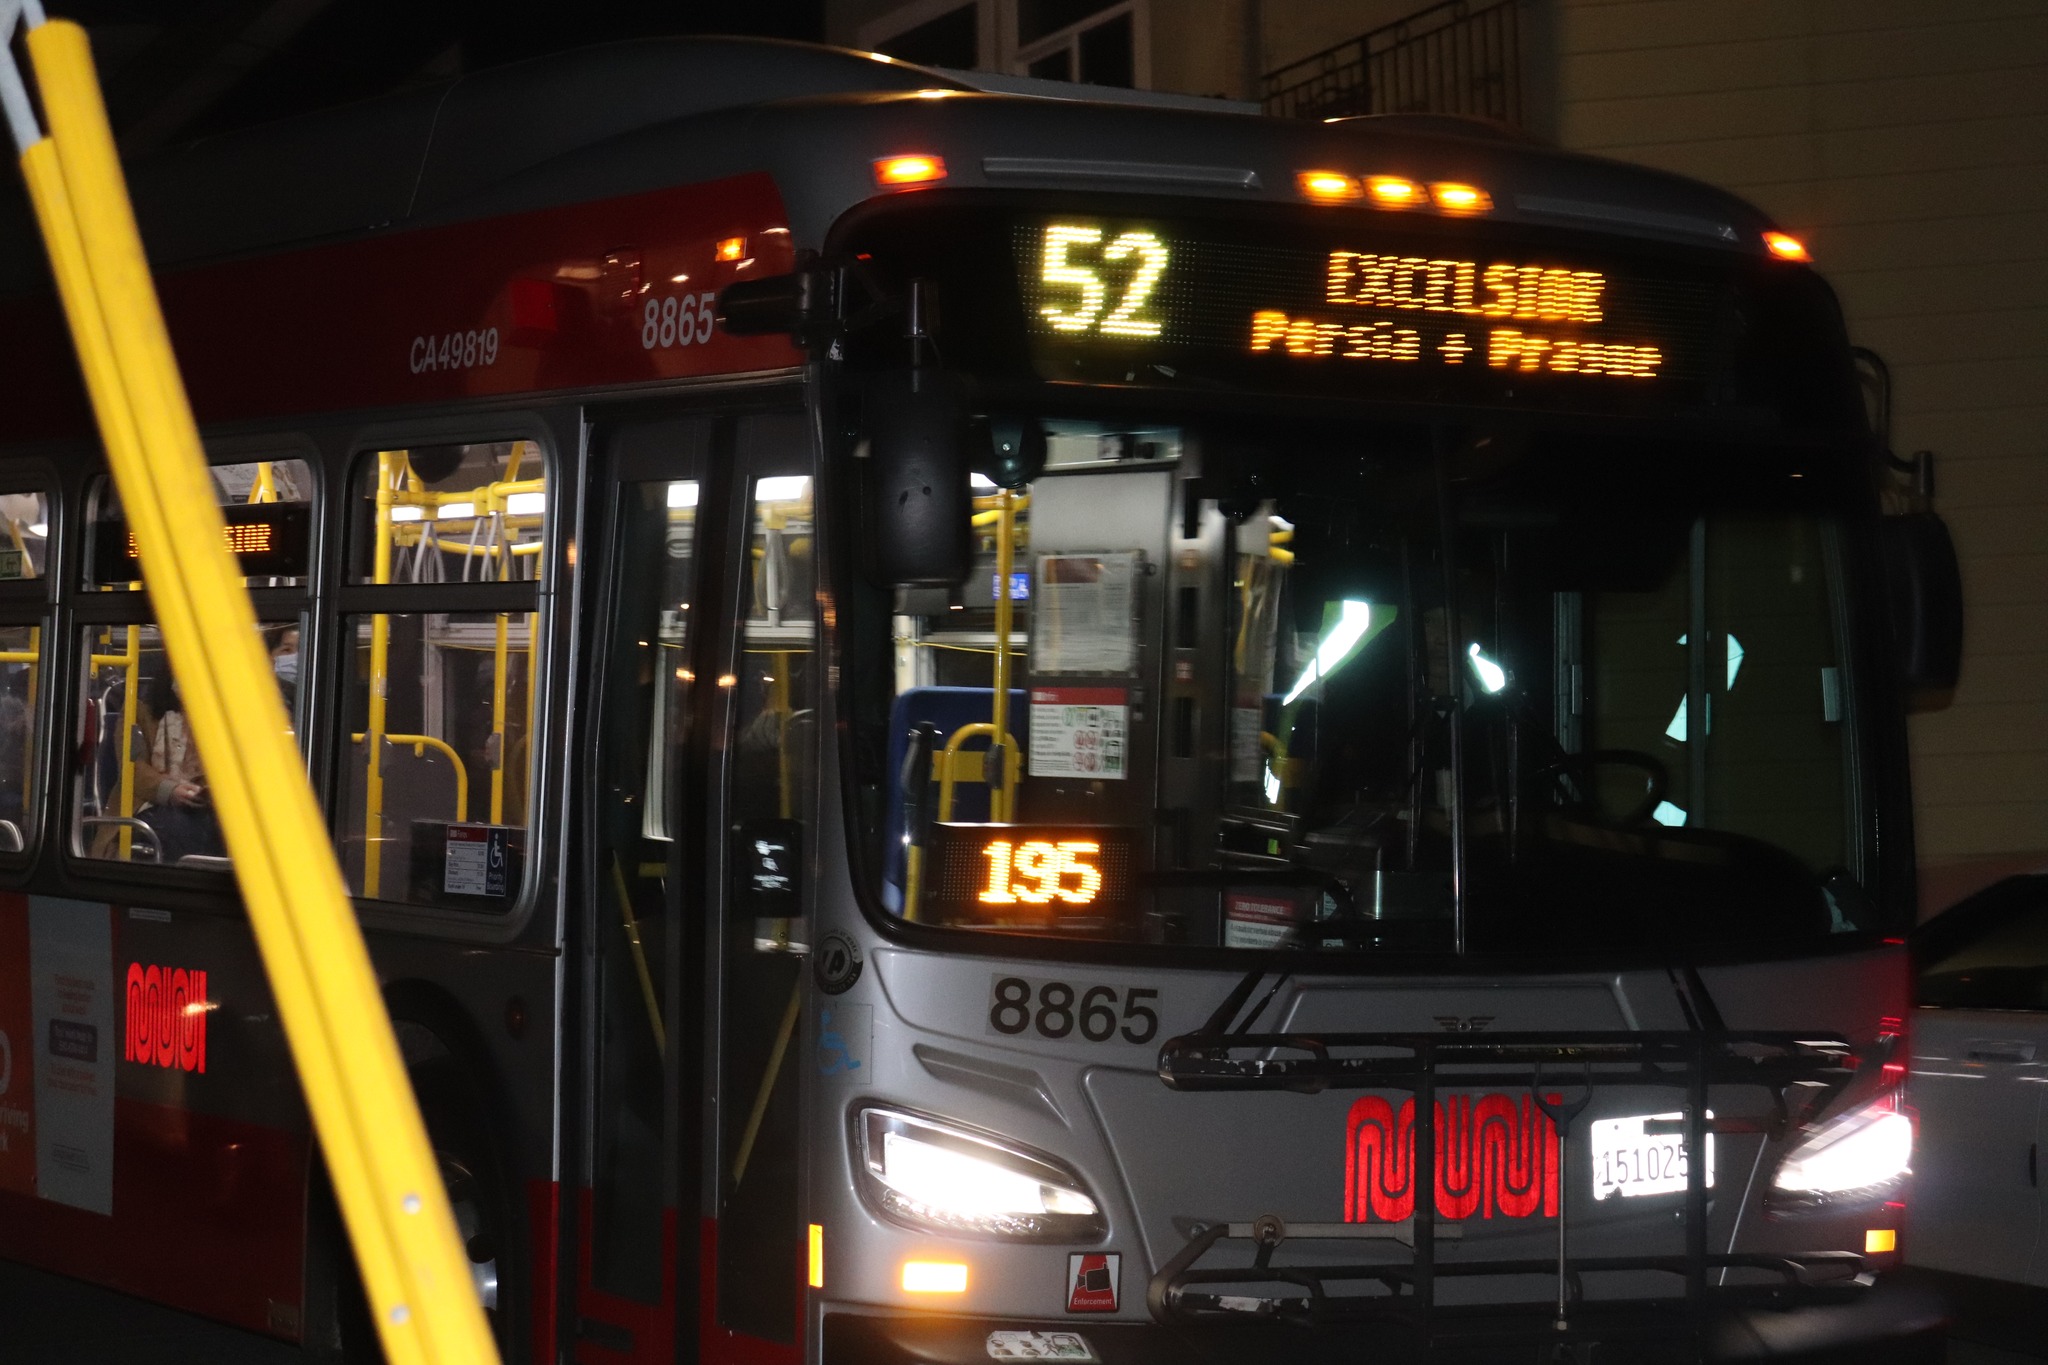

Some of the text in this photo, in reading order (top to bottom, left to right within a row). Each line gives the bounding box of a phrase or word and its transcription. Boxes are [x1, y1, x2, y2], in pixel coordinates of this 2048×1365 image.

[1041, 225, 1168, 336] 52
[642, 292, 715, 350] 8865
[409, 326, 498, 375] CA49819
[979, 841, 1102, 903] 195
[1234, 901, 1285, 914] ZERO TOLERANCE
[989, 977, 1159, 1045] 8865
[1602, 1144, 1689, 1187] 151025
[1073, 1297, 1112, 1305] Enforcement
